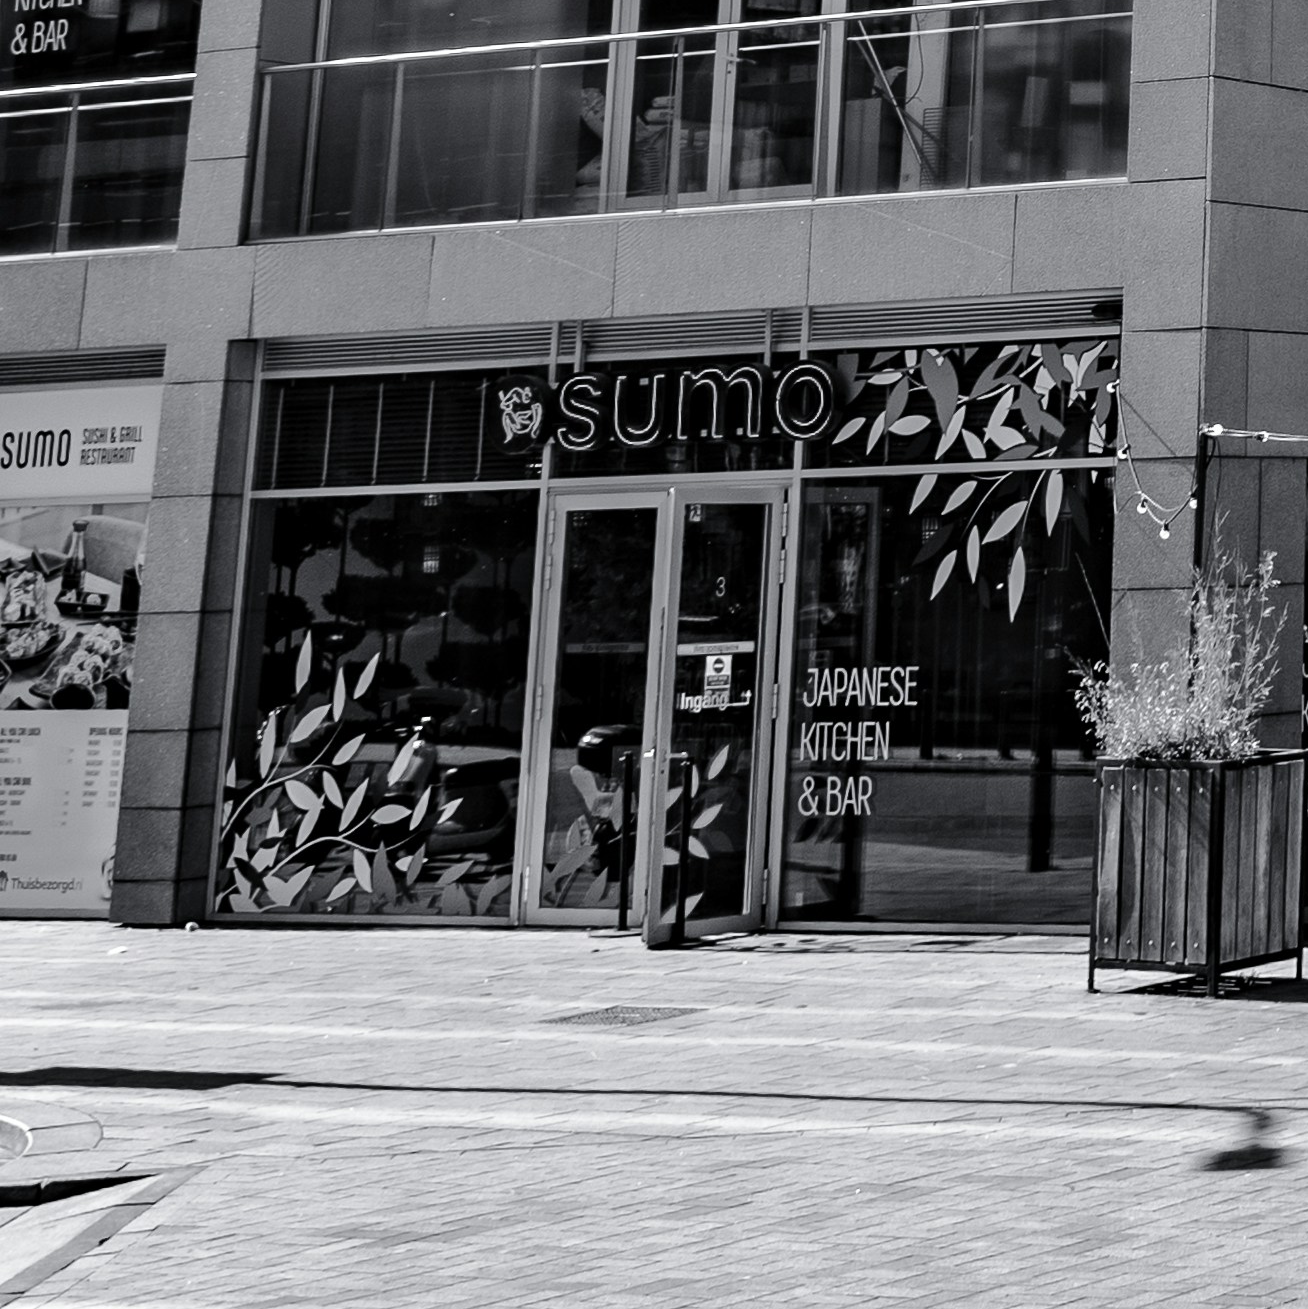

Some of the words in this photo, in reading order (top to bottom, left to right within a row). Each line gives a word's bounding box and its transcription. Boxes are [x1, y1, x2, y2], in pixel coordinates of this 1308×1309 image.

[10, 23, 28, 55] &
[31, 19, 69, 53] BAR
[715, 576, 726, 597] 3
[680, 692, 729, 714] Ingang
[802, 665, 920, 708] JAPANESE
[800, 720, 891, 762] KITCHEN
[797, 775, 819, 817] &
[825, 775, 873, 817] BAR
